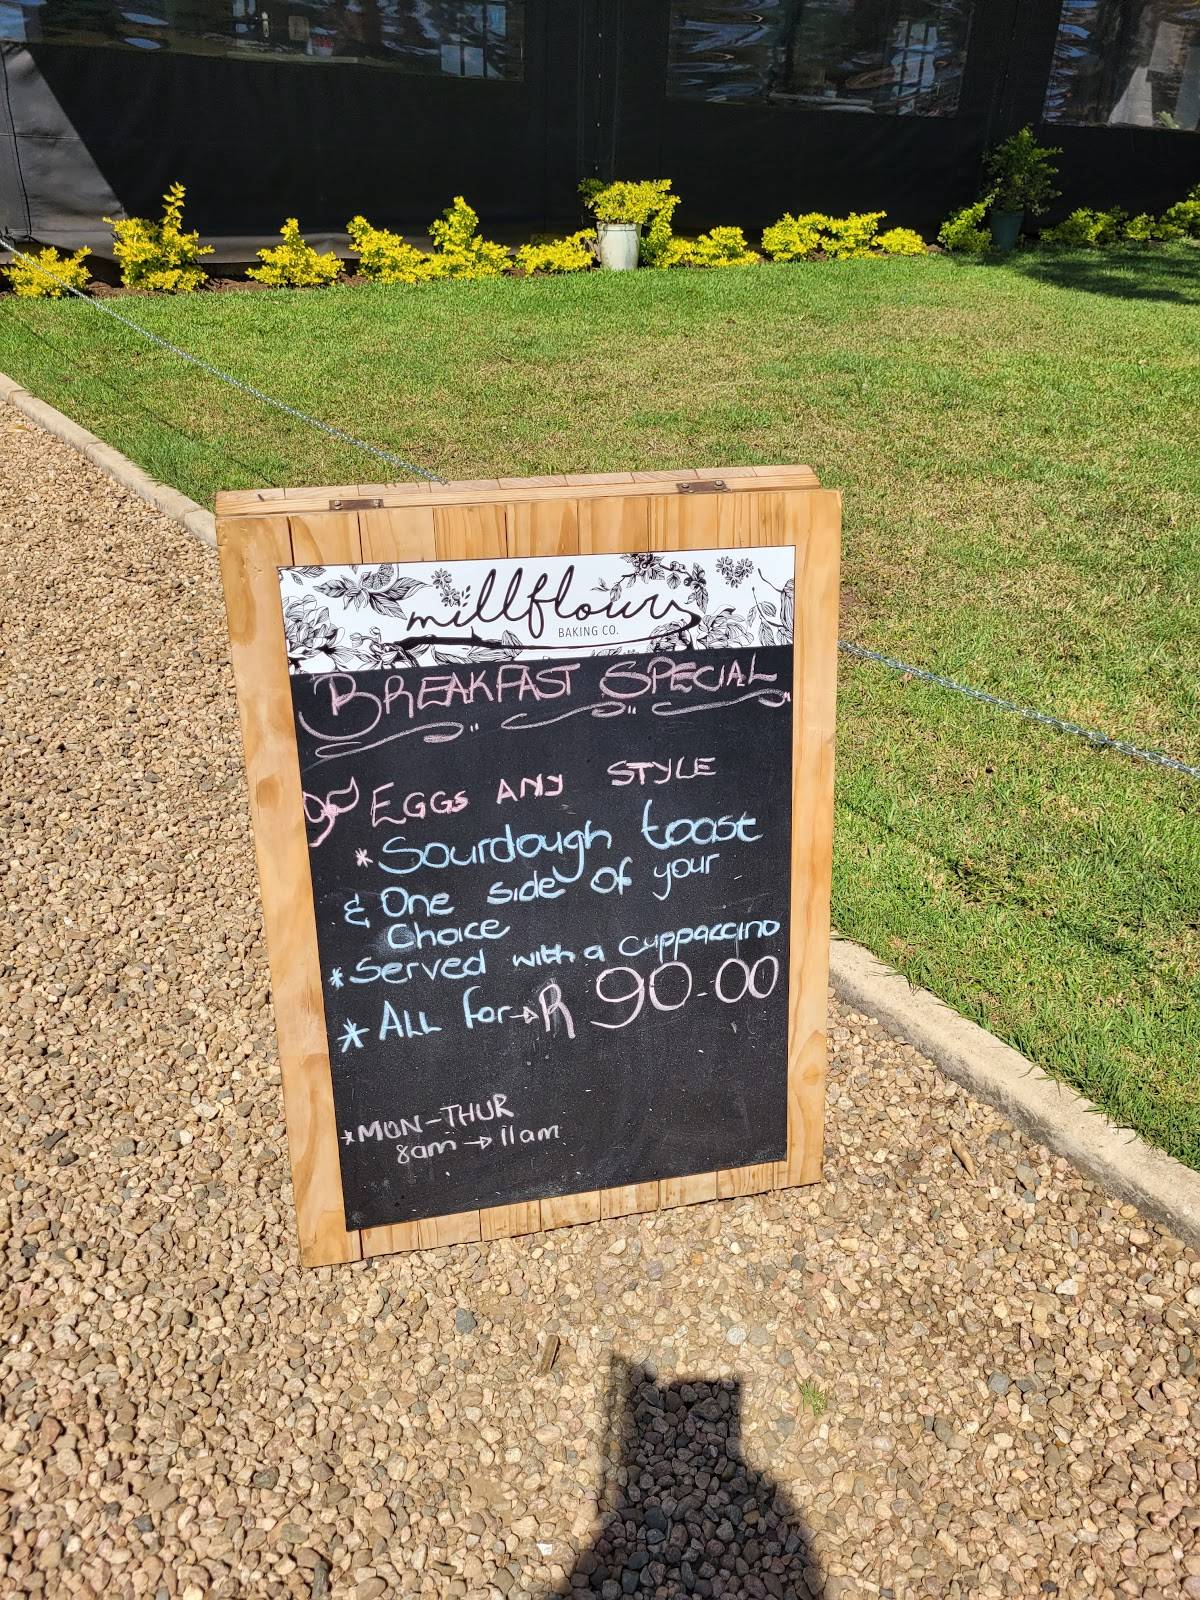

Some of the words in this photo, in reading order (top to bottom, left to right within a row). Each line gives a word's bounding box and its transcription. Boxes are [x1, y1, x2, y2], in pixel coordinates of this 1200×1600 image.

[558, 626, 598, 638] BAKING
[602, 624, 619, 636] CO.
[299, 663, 579, 740] BREAKFAST
[600, 654, 777, 699] SPECIAL
[607, 757, 716, 786] STYLE
[378, 820, 612, 883] Sourdough
[642, 799, 764, 849] toast
[380, 886, 455, 918] One
[653, 853, 720, 900] your
[512, 943, 576, 968] with
[583, 945, 605, 962] a
[396, 1140, 457, 1164] 8am
[501, 1124, 560, 1147] 11am
